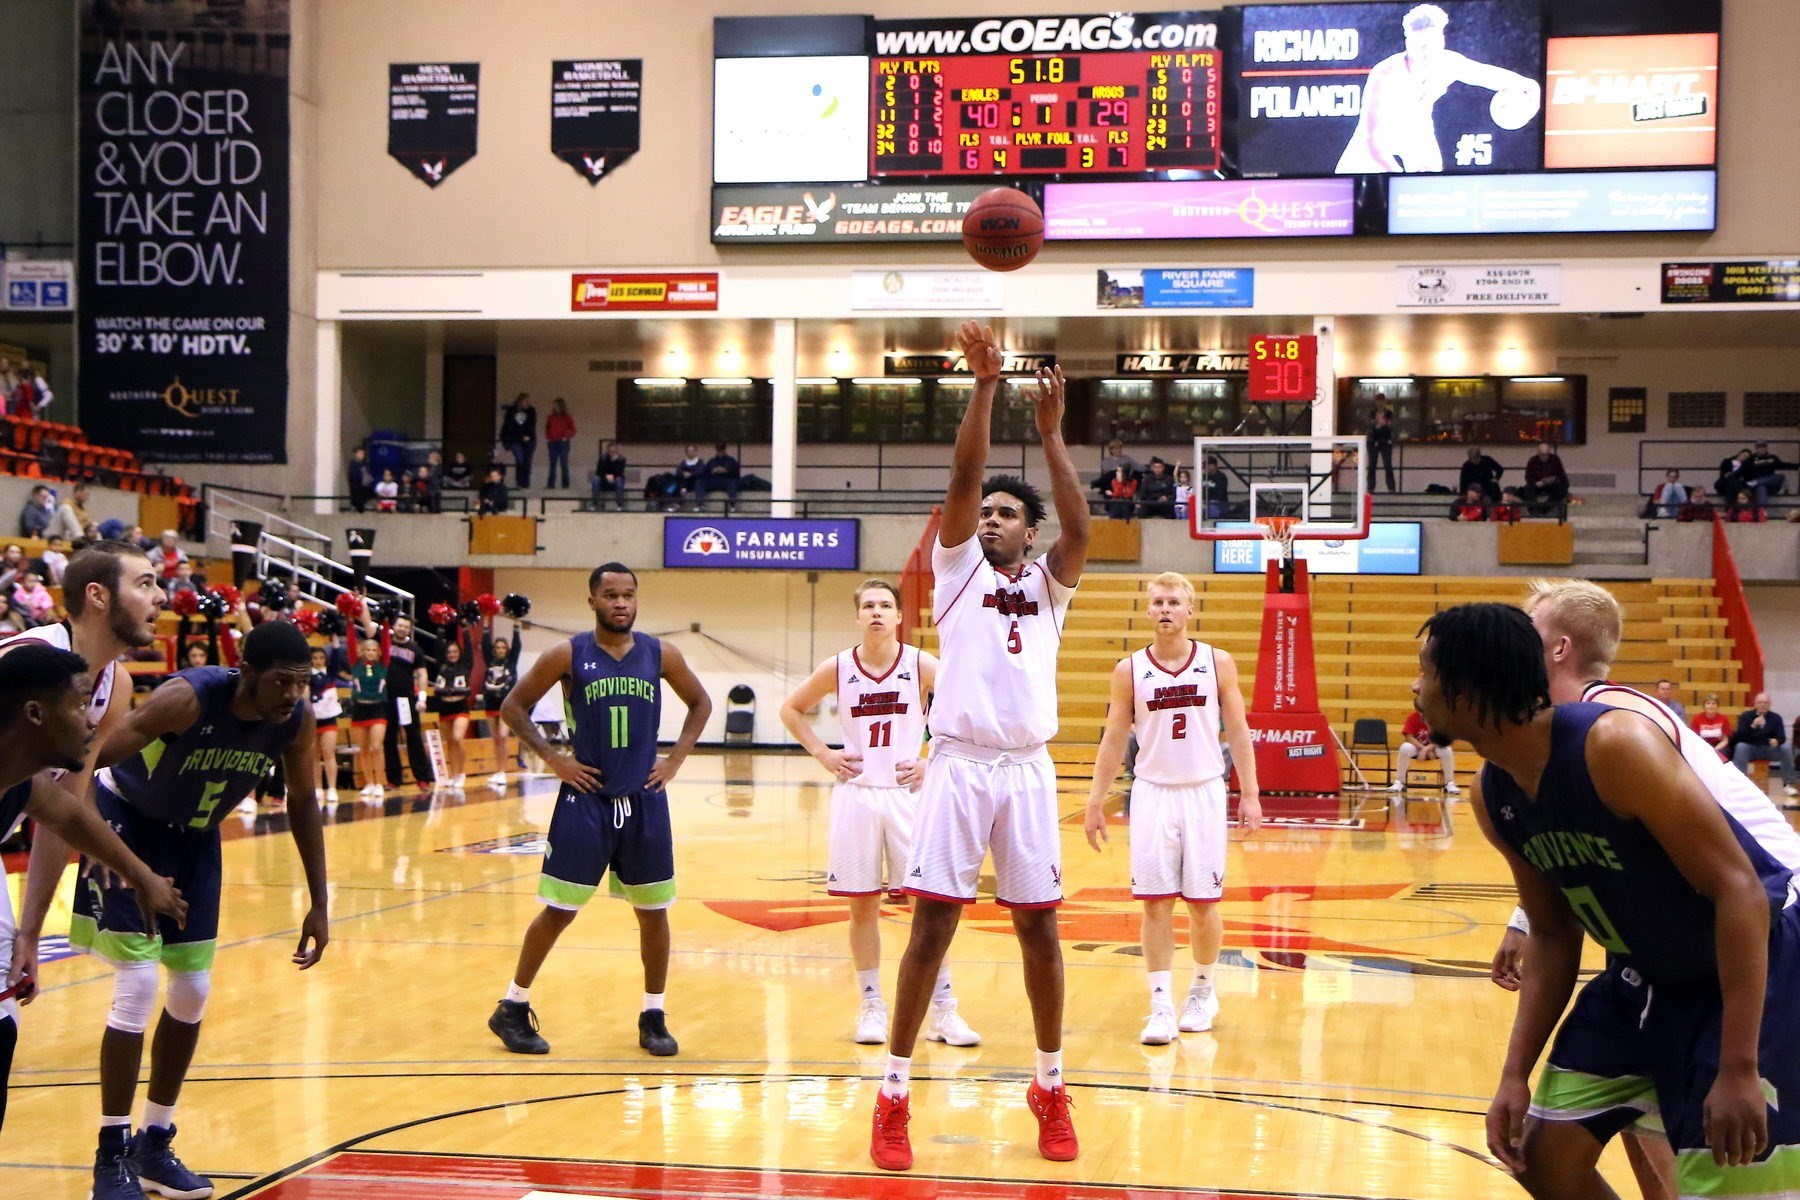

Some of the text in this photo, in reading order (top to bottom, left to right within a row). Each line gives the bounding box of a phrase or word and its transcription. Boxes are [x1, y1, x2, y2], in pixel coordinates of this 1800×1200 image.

[876, 17, 1218, 54] www.GOEAGS.com
[1254, 28, 1359, 62] RICHARD
[95, 41, 186, 84] ANY
[880, 61, 941, 74] PLY FL PTS
[1152, 54, 1213, 68] PLY FL PTS
[1010, 58, 1064, 84] 51.8
[1158, 69, 1216, 84] 5 0 5
[886, 75, 943, 90] 2 0 9
[886, 92, 943, 106] 5 1 2
[962, 88, 999, 101] EAGLES
[1092, 86, 1125, 99] ARGOS
[1152, 86, 1167, 100] 10
[1207, 86, 1216, 98] 6
[1152, 102, 1215, 116] 11 0 0
[1250, 85, 1360, 118] POLANCO
[96, 90, 253, 136] CLOSER
[880, 108, 943, 121] 11 1 2
[968, 104, 999, 128] 40
[1045, 106, 1051, 123] 1
[1097, 101, 1128, 126] 29
[877, 124, 895, 139] 32
[909, 124, 920, 138] 0
[1146, 119, 1167, 133] 23
[1207, 119, 1215, 131] 3
[959, 133, 980, 146] FLS
[1015, 132, 1041, 145] PLYR
[1047, 132, 1073, 145] FOUL
[1108, 131, 1129, 143] FLS
[1146, 136, 1166, 150] 24
[877, 140, 942, 155] 34 0 10
[1455, 133, 1492, 166] #5
[95, 138, 262, 186] & YOU'D
[966, 148, 1127, 169] 6 4 3 7
[893, 192, 948, 203] JOIN THE
[94, 191, 267, 236] TAKE AN
[720, 206, 804, 224] EAGLE
[929, 202, 953, 213] THE
[1238, 187, 1330, 232] QUEST
[835, 220, 964, 235] GOEAGS.COM
[95, 242, 244, 286] ELBOW.
[1162, 271, 1236, 280] RIVER PARK
[1172, 280, 1225, 288] SQUARE
[1466, 293, 1549, 301] FREE DELIVERY
[95, 317, 265, 331] WATCH THE GAME ON OUR
[96, 332, 127, 353] 30'
[149, 333, 178, 353] 10'
[182, 334, 251, 355] HDTV.
[1255, 340, 1299, 360] 51.8
[1123, 356, 1174, 370] HALL
[1196, 356, 1249, 371] FAME
[1265, 361, 1302, 394] 30
[162, 377, 240, 417] QUEST
[736, 532, 839, 547] FARMERS
[736, 550, 805, 560] INSURANCE
[1221, 549, 1254, 564] HERE
[1007, 621, 1022, 654] 5
[584, 677, 655, 705] PROVIDENCE
[609, 706, 629, 748] 11
[869, 720, 891, 747] 11
[1172, 713, 1187, 740] 2
[188, 780, 228, 828] 5
